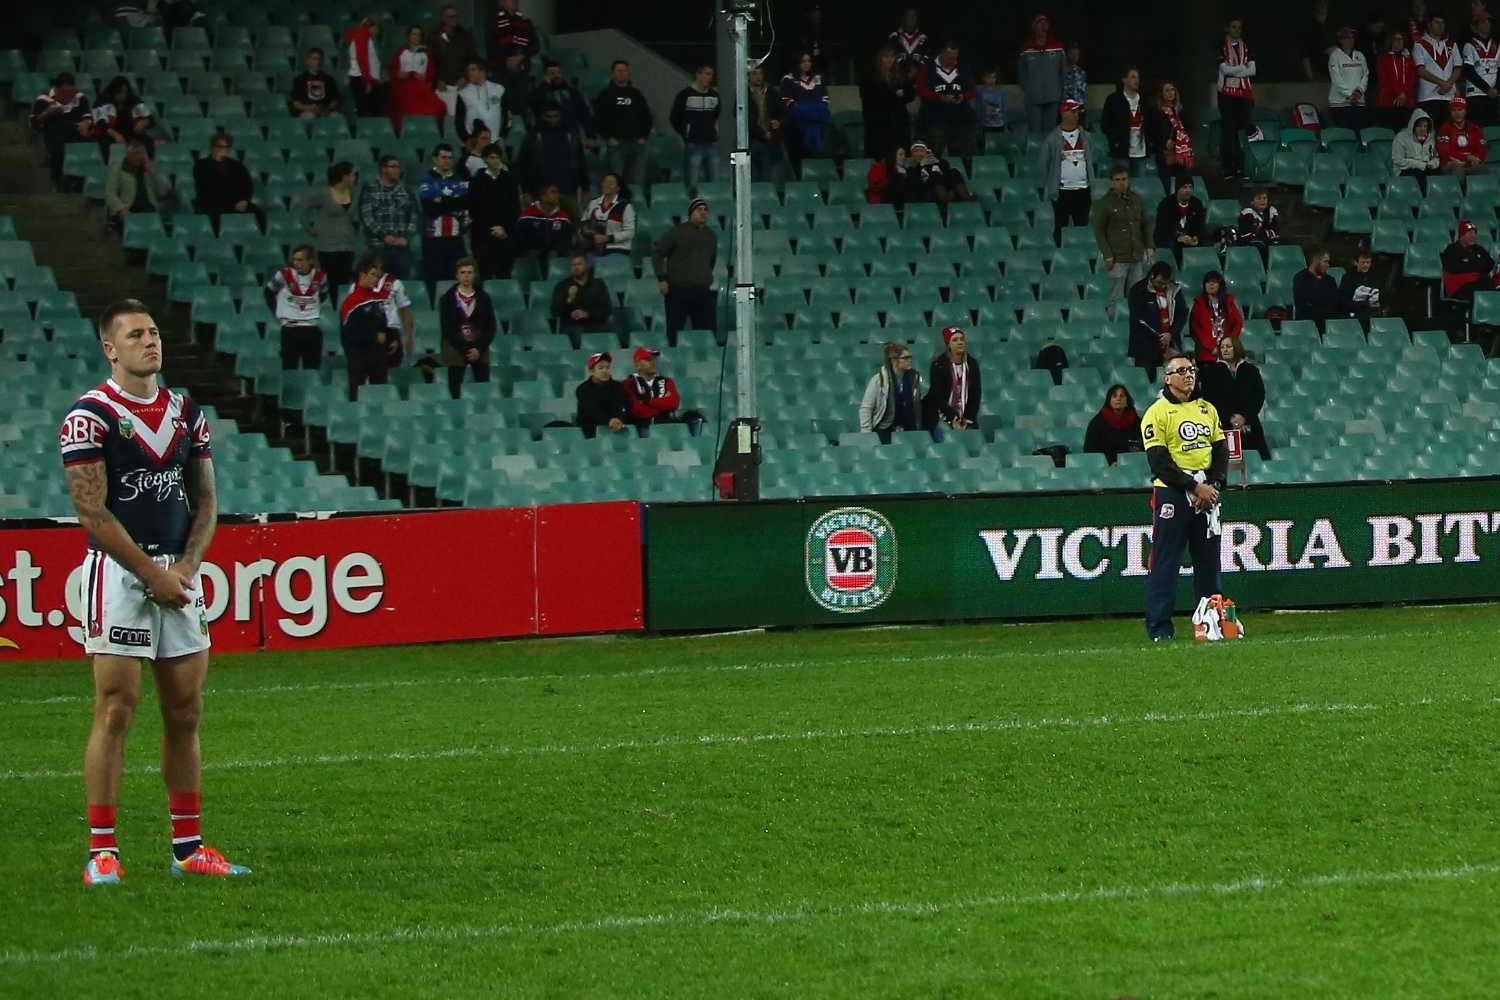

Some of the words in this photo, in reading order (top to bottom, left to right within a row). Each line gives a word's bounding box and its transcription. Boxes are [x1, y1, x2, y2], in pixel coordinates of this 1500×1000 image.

[59, 416, 105, 446] QBE
[829, 546, 874, 574] VB
[978, 521, 1352, 581] VICTRIA
